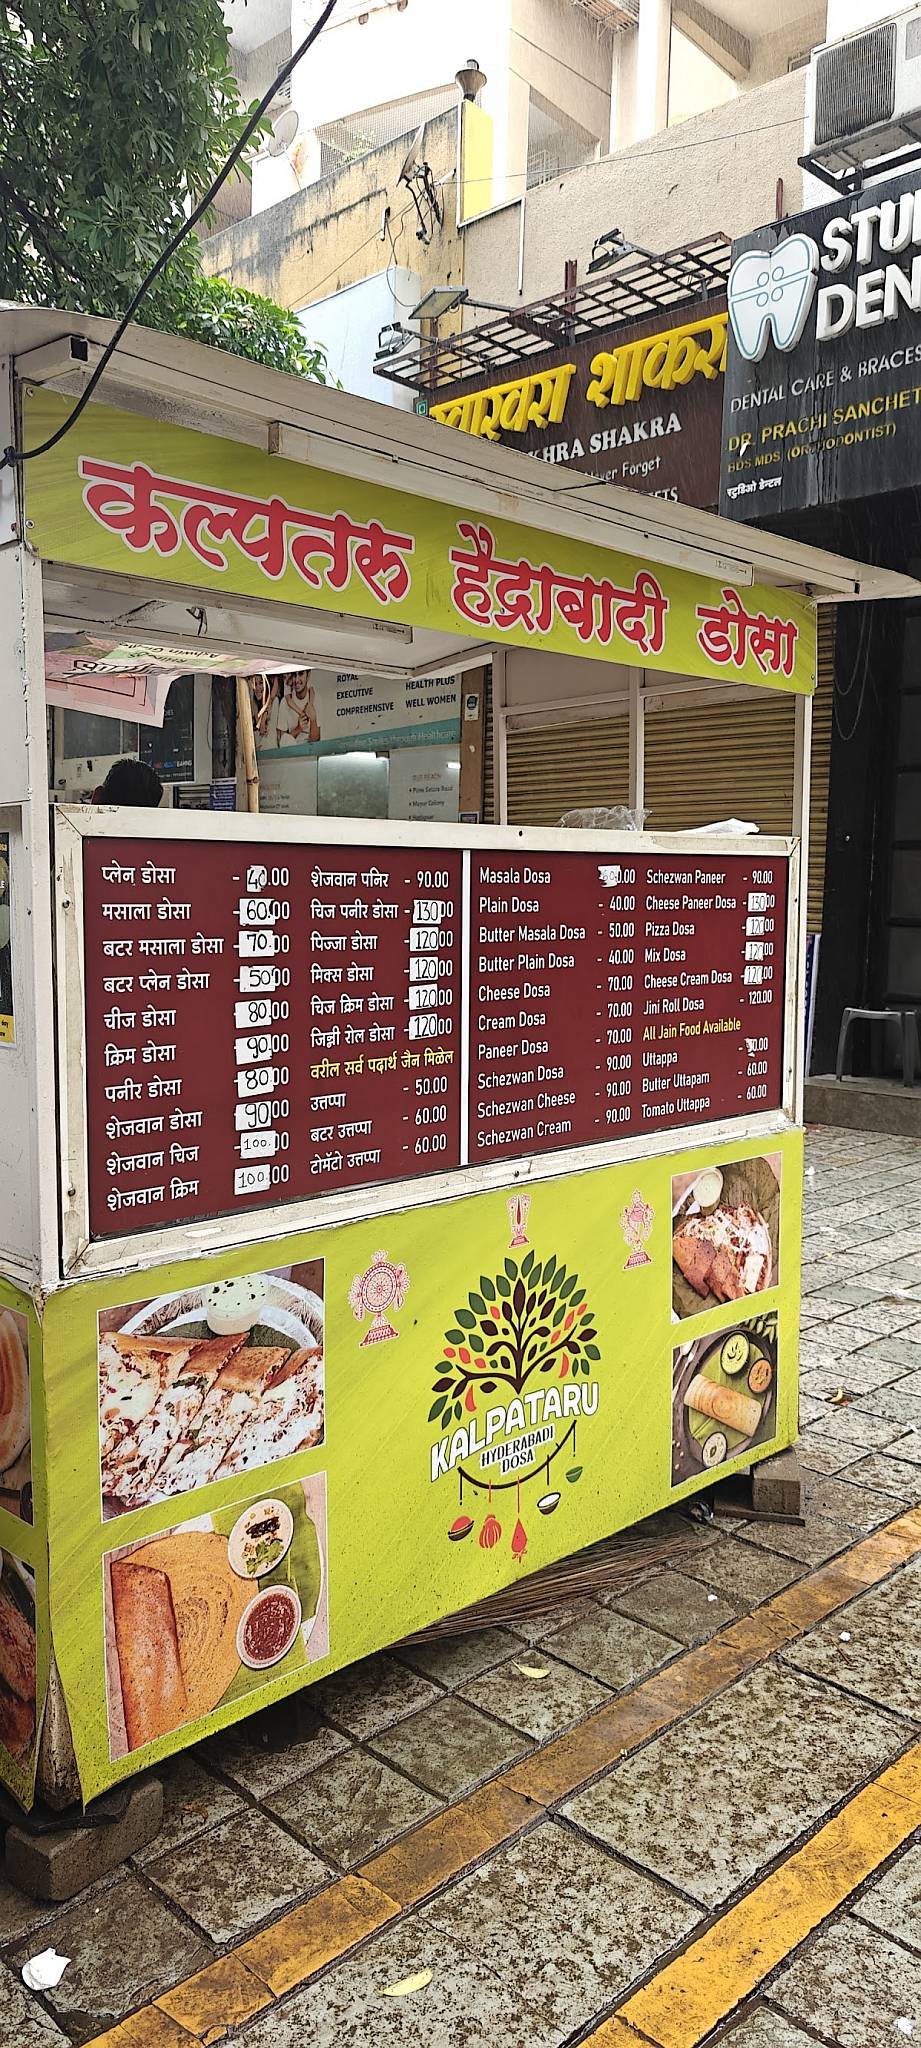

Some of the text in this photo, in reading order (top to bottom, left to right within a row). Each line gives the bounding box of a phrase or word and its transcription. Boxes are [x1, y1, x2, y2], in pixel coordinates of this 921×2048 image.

[730, 344, 921, 414] DENTAL CARE & BRACES
[589, 412, 682, 453] SHAKRA
[761, 414, 828, 444] PRACHI
[623, 457, 661, 482] Forget
[727, 458, 752, 473] BDS
[755, 451, 781, 467] MDS
[696, 587, 798, 678] डोसा
[336, 687, 373, 700] EXECUTIVE
[405, 675, 456, 690] HEALTH PLUS
[336, 701, 395, 717] COMPREHENSIVE
[405, 693, 457, 709] WELL WOMEN
[101, 860, 136, 884] प्लेन
[141, 860, 176, 884] डोसा
[310, 865, 449, 888] शेजवान पनिर 90.00
[479, 867, 551, 884] Masala Dosa
[646, 869, 773, 884] Schezwan Paneer 90.00
[102, 903, 152, 920] मसाला
[156, 896, 192, 920] डोसा
[310, 898, 399, 919] चिज पनीर डोसा
[479, 896, 635, 913] Plain Dosa 40.00
[645, 895, 736, 910] Cheese Paneer Dosa
[310, 930, 378, 951] पिज्जा डोसा
[479, 923, 635, 943] Butter Masala Dosa 50.00
[645, 921, 695, 937] Pizza Dosa
[102, 940, 133, 956] बटर
[138, 939, 186, 955] मसाला
[191, 931, 224, 954] डोसा
[644, 948, 686, 963] Mix Dosa
[310, 962, 374, 984] मिक्स डोसा
[479, 949, 634, 972] Butter Plain Dosa 40.00
[102, 967, 210, 993] बटर प्लेन डोसा
[478, 975, 633, 1002] Cheese Dosa 70.00
[644, 970, 732, 989] Cheese Cream Dosa
[310, 992, 394, 1016] चिज क्रिम डोसा
[643, 990, 773, 1015] Jini Roll Dosa 120.00
[104, 1006, 136, 1030] चीज
[141, 1004, 176, 1027] डोसा
[478, 1002, 633, 1031] Cream Dosa 70.00
[643, 1017, 741, 1041] All Jain Food Available
[345, 1025, 365, 1044] रोल
[369, 1022, 395, 1041] डोसा
[478, 1028, 632, 1061] Paneer Dosa 70.00
[104, 1043, 136, 1067] क्रिम
[141, 1040, 176, 1063] डोसा
[310, 1046, 454, 1079] वरील सर्व पदार्थ जैन मिळेल
[642, 1052, 678, 1068] Uttappa
[477, 1054, 632, 1089] Schezwan Dosa 90.00
[642, 1061, 768, 1093] Butter Uttapam 60.00
[105, 1077, 142, 1102] पनीर
[148, 1075, 182, 1098] डोसा
[310, 1076, 448, 1111] उत्तप्पा 50.00
[477, 1080, 631, 1119] Schezwan Cheese 90.00
[642, 1084, 767, 1118] Tomato Uttappa 60.00
[106, 1108, 203, 1139] शेजवान डोसा
[310, 1105, 447, 1142] बटर उत्तप्पा 60.00
[477, 1106, 631, 1147] Schezwan Cream 90.00
[106, 1152, 164, 1175] शेजवान
[170, 1143, 199, 1165] चिज
[310, 1134, 447, 1174] टोमॅटो उत्तप्पा 60.00
[107, 1188, 165, 1211] शेजवान
[170, 1177, 199, 1199] क्रिम
[430, 1382, 599, 1483] KALPATARU
[481, 1425, 554, 1467] HYDERABADI
[502, 1450, 534, 1473] DOSA
